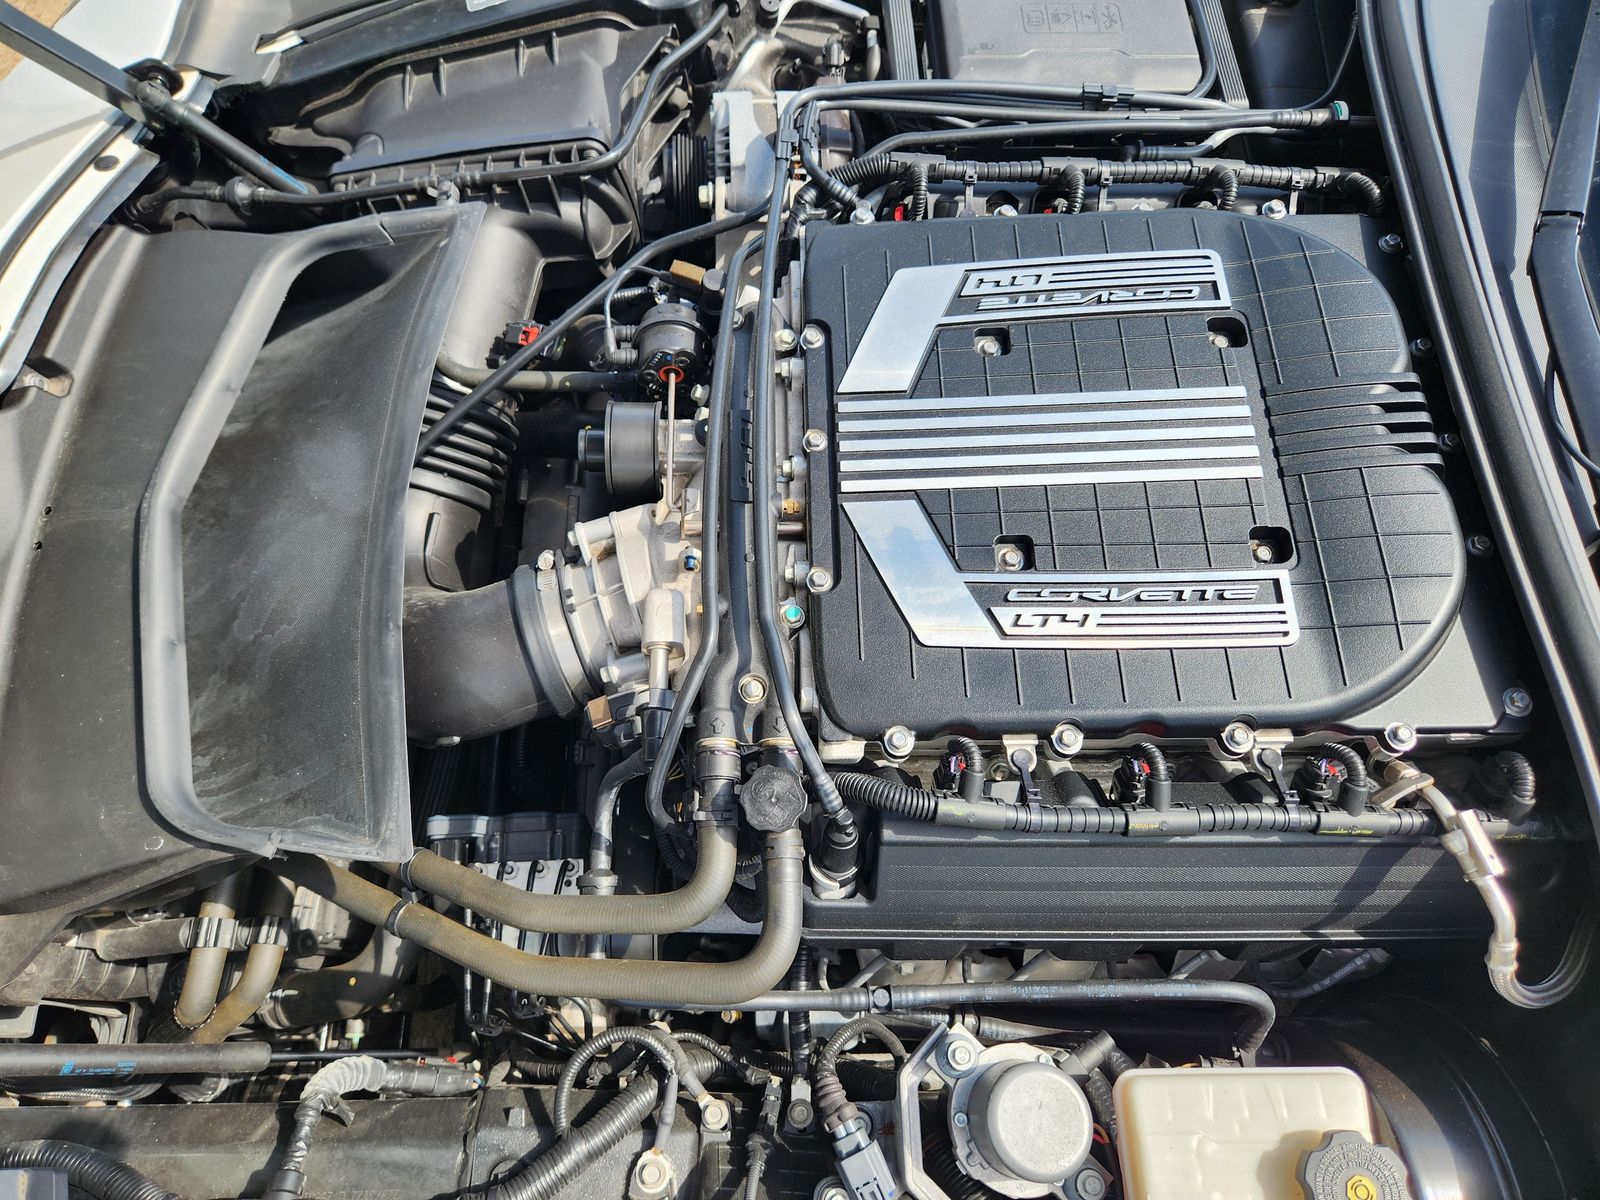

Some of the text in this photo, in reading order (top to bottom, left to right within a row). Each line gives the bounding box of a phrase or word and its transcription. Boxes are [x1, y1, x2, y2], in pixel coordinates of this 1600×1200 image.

[976, 273, 1043, 290] LT4
[977, 285, 1201, 312] CORVETTE
[1005, 584, 1260, 603] CORVETTE
[1010, 613, 1090, 628] LT4
